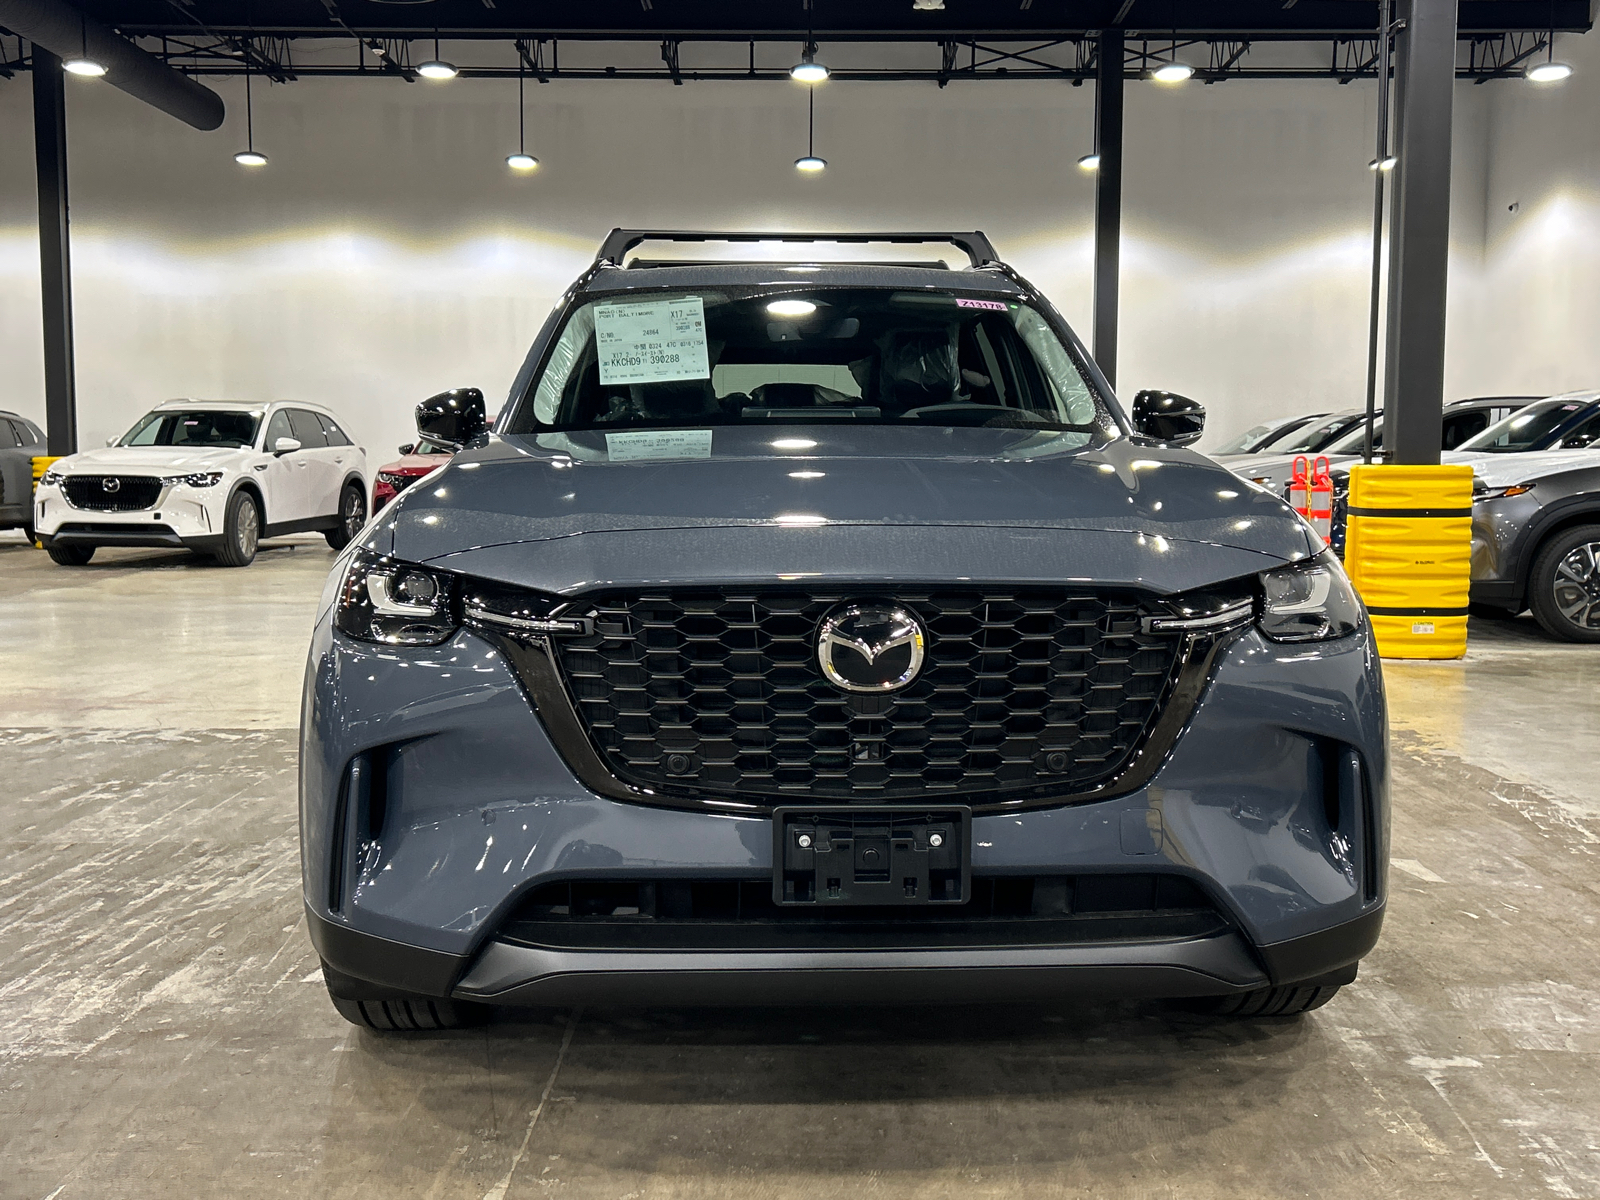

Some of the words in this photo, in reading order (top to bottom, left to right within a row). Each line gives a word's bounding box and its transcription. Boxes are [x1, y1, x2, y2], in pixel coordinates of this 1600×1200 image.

[670, 310, 682, 318] X17
[611, 357, 641, 367] KKCHD9
[650, 354, 680, 364] 390288
